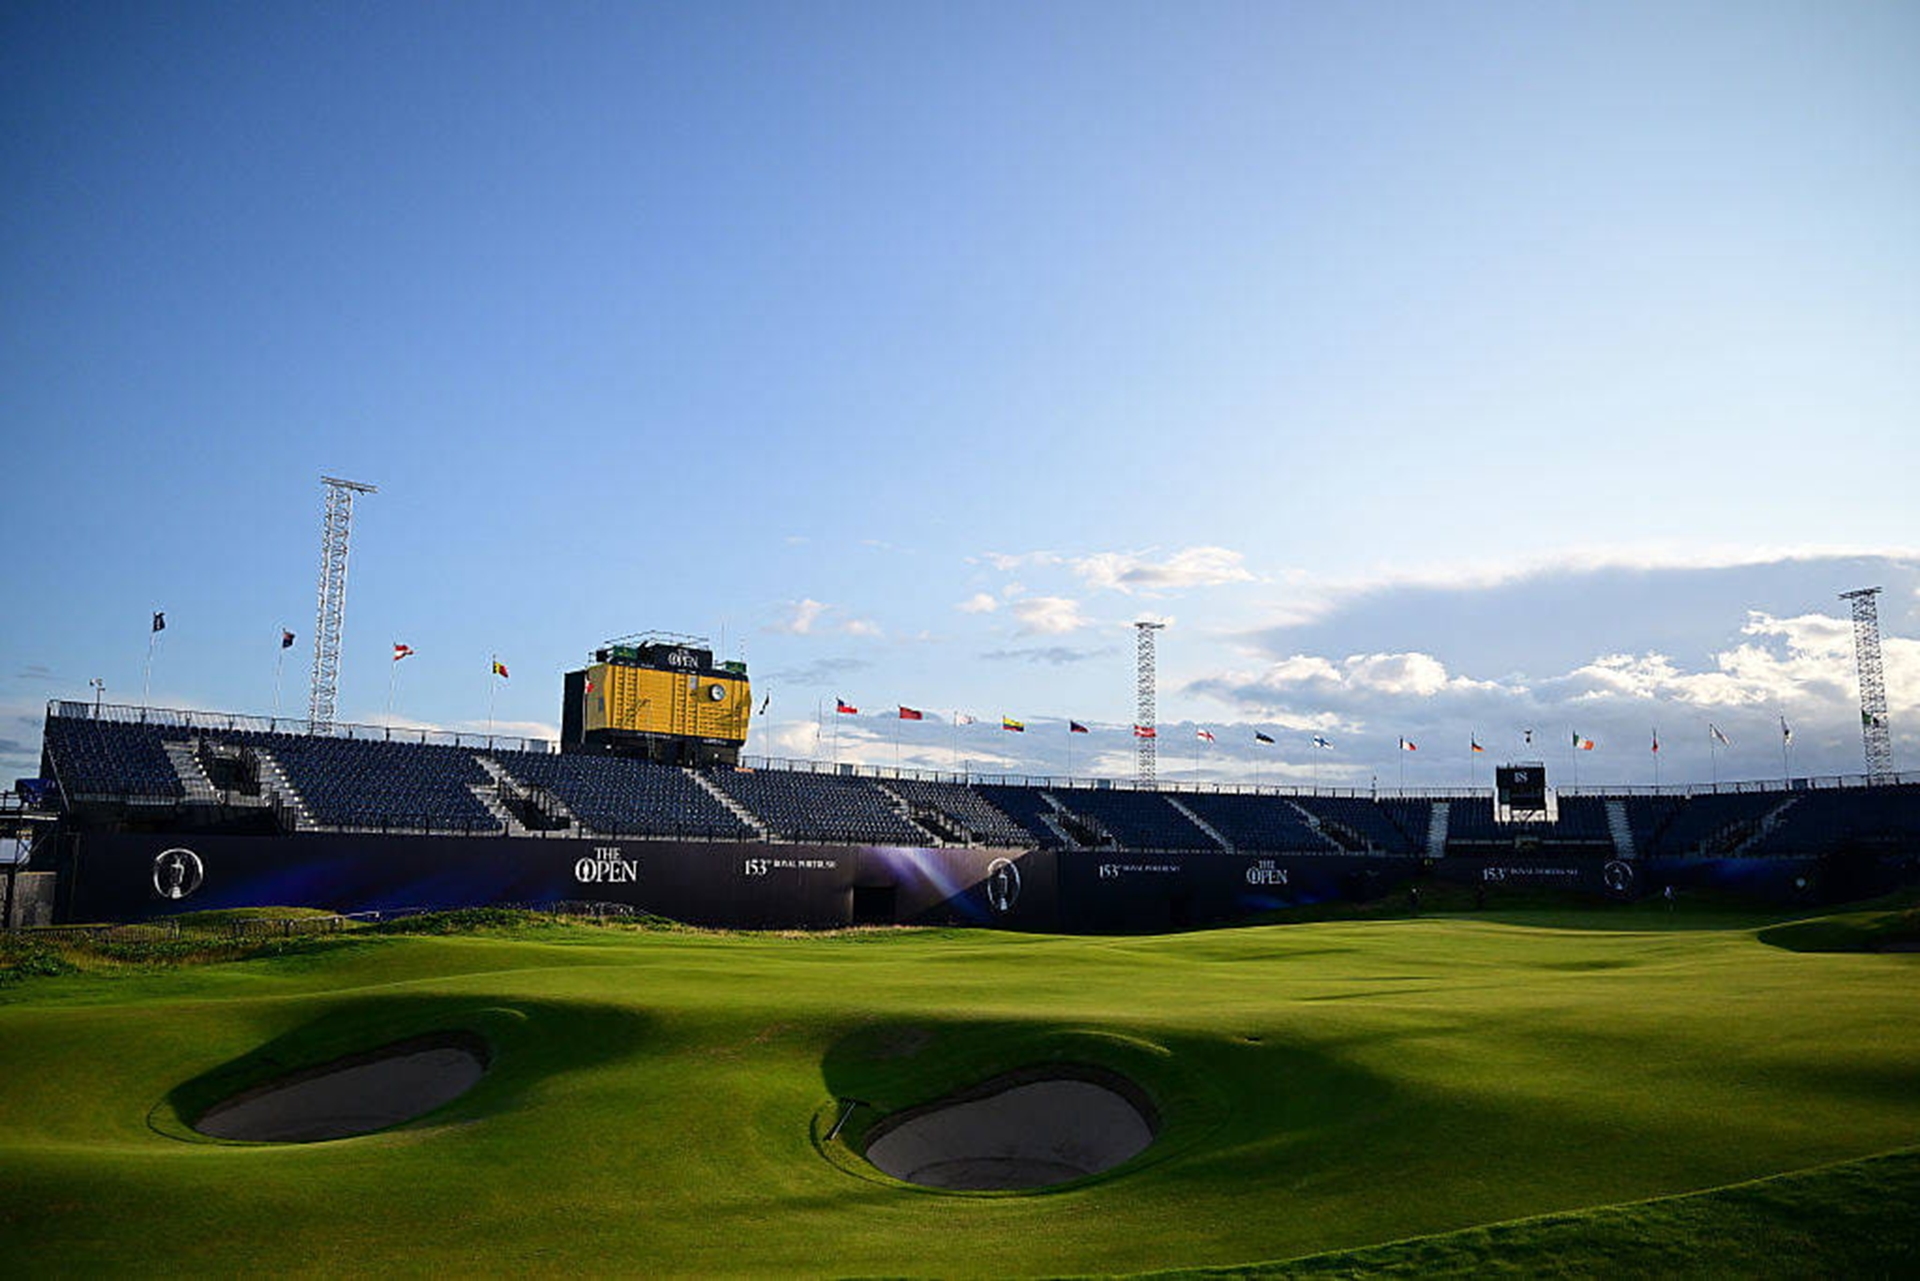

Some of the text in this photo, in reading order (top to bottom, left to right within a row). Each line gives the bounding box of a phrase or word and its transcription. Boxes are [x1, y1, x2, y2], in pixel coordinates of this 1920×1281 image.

[594, 847, 621, 860] THE
[575, 857, 638, 882] OPEN
[1246, 866, 1287, 884] OPEN
